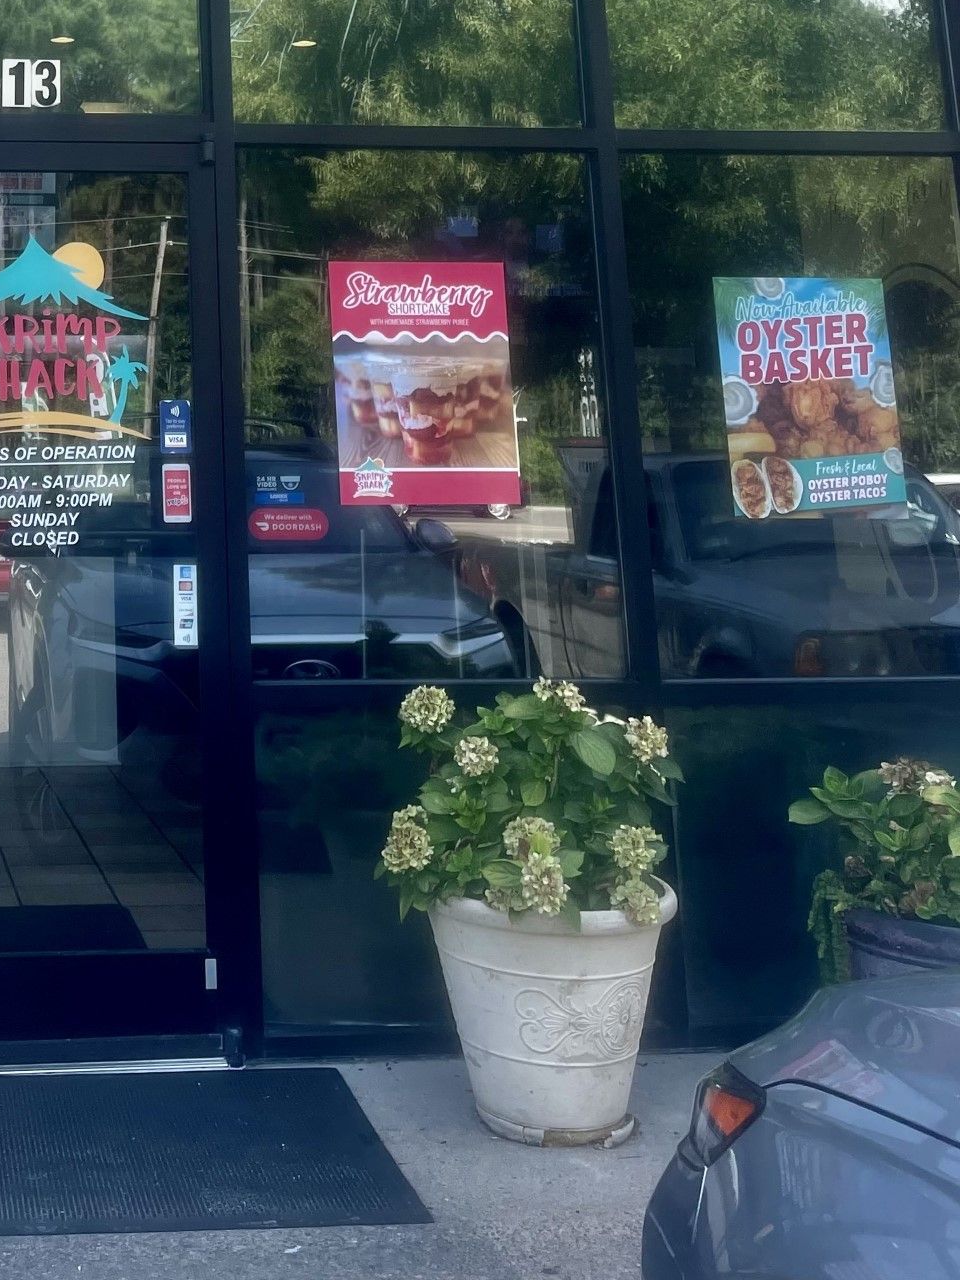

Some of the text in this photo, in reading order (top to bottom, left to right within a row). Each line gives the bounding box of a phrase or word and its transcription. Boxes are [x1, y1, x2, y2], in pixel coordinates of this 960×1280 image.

[8, 61, 57, 106] 13
[343, 271, 494, 318] Strawberry
[389, 302, 449, 315] SHORTCAKE
[735, 291, 867, 322] Now Available
[737, 314, 867, 352] OYSTER
[741, 345, 874, 385] BASKET
[14, 447, 37, 460] OF
[41, 445, 136, 460] OPERATION
[816, 461, 843, 475] Fresh
[852, 459, 876, 474] Local
[41, 474, 130, 489] SATURDAY
[808, 474, 888, 490] OYSTER POBOY
[55, 493, 113, 507] 9:00PM
[810, 486, 887, 503] OYSTER TACOS
[11, 512, 79, 528] SUNDAY
[272, 521, 322, 532] DOORDASH
[11, 531, 79, 546] CLOSED
